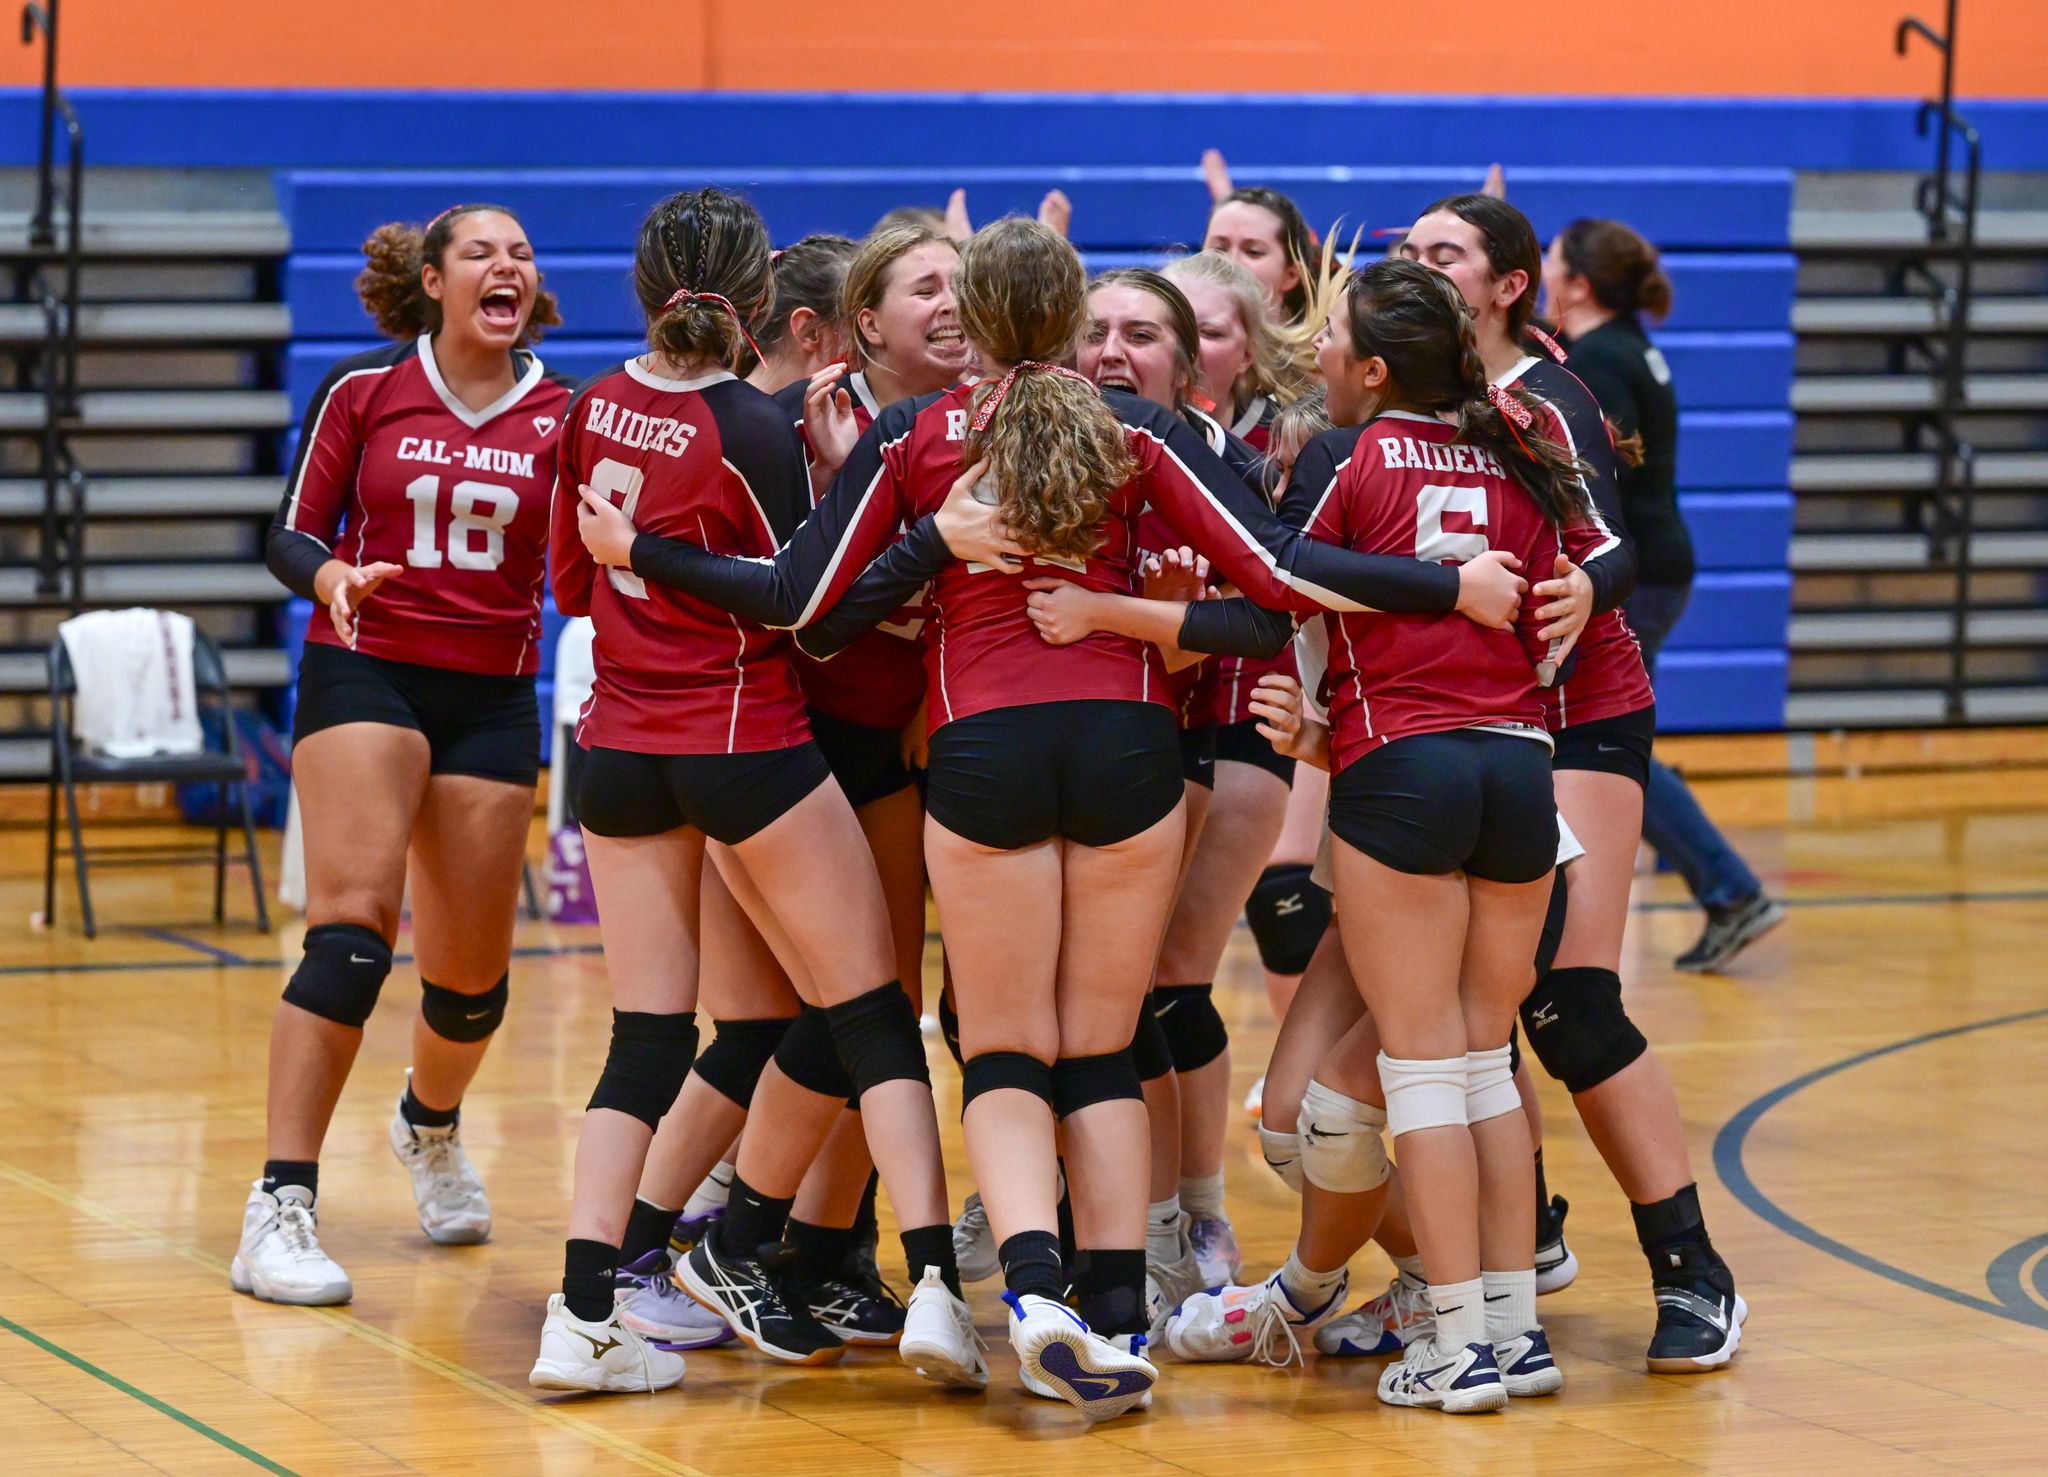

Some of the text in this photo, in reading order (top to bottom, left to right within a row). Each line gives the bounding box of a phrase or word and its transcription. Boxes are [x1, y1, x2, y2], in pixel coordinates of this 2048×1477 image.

[397, 436, 535, 479] CAL-MUM
[586, 397, 697, 458] RAIDERS
[405, 474, 520, 571] 18
